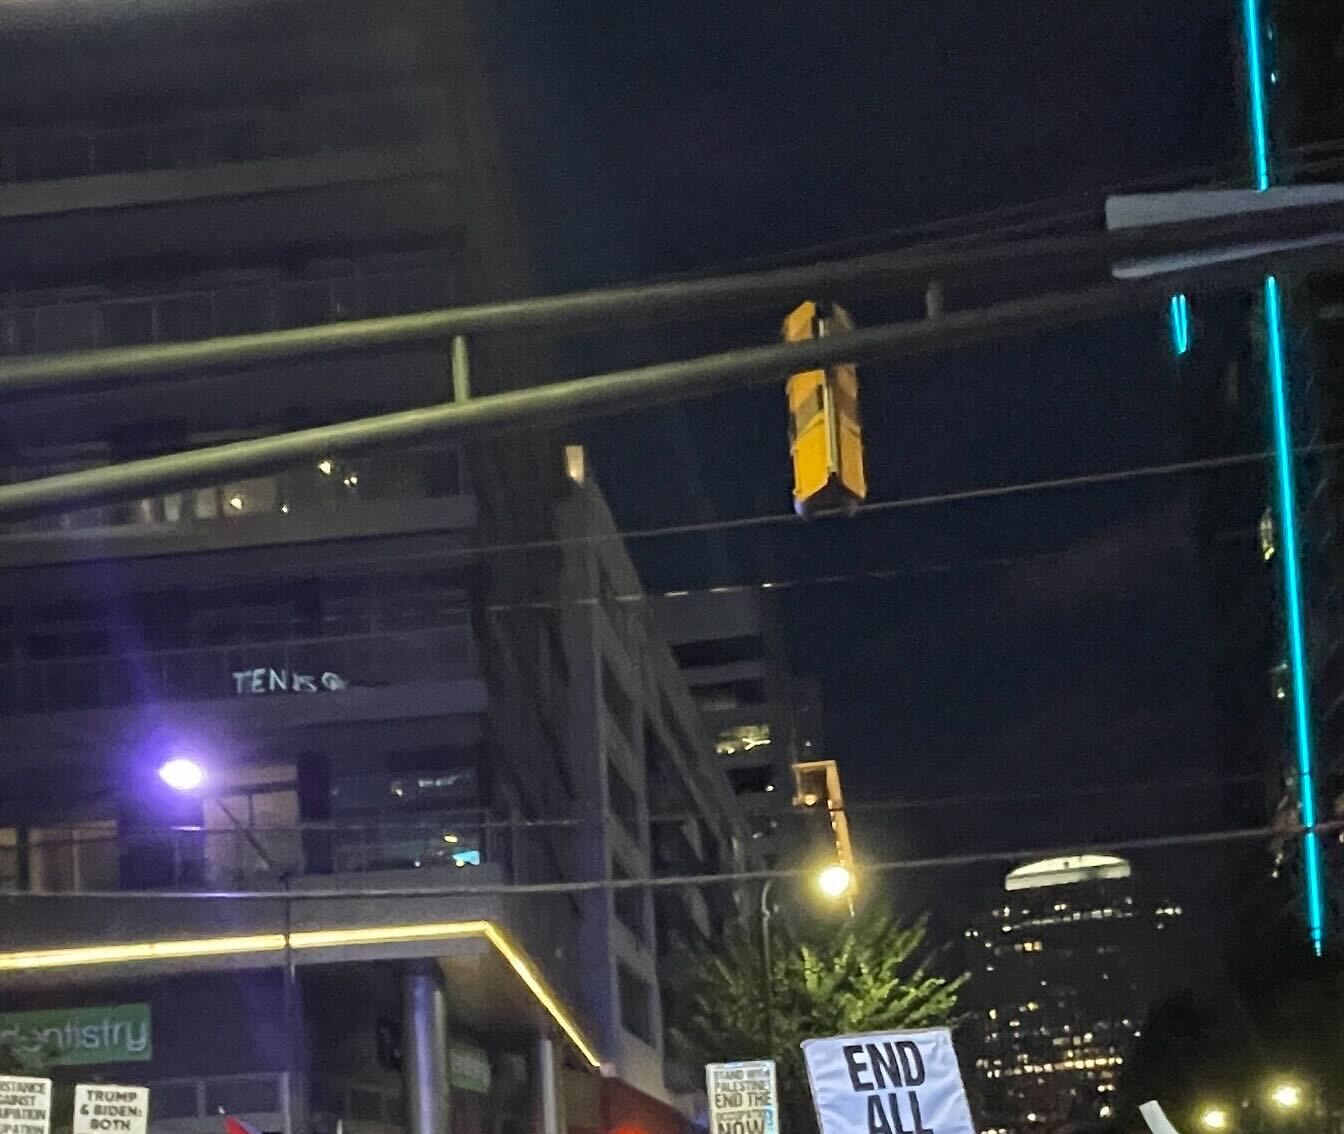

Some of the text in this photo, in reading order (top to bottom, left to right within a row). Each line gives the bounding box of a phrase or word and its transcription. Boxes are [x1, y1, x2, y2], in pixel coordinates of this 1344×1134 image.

[842, 1040, 926, 1092] END
[86, 1089, 138, 1103] TRUMP
[714, 1091, 772, 1108] END THE
[79, 1103, 90, 1116] &
[89, 1118, 131, 1131] BOTH
